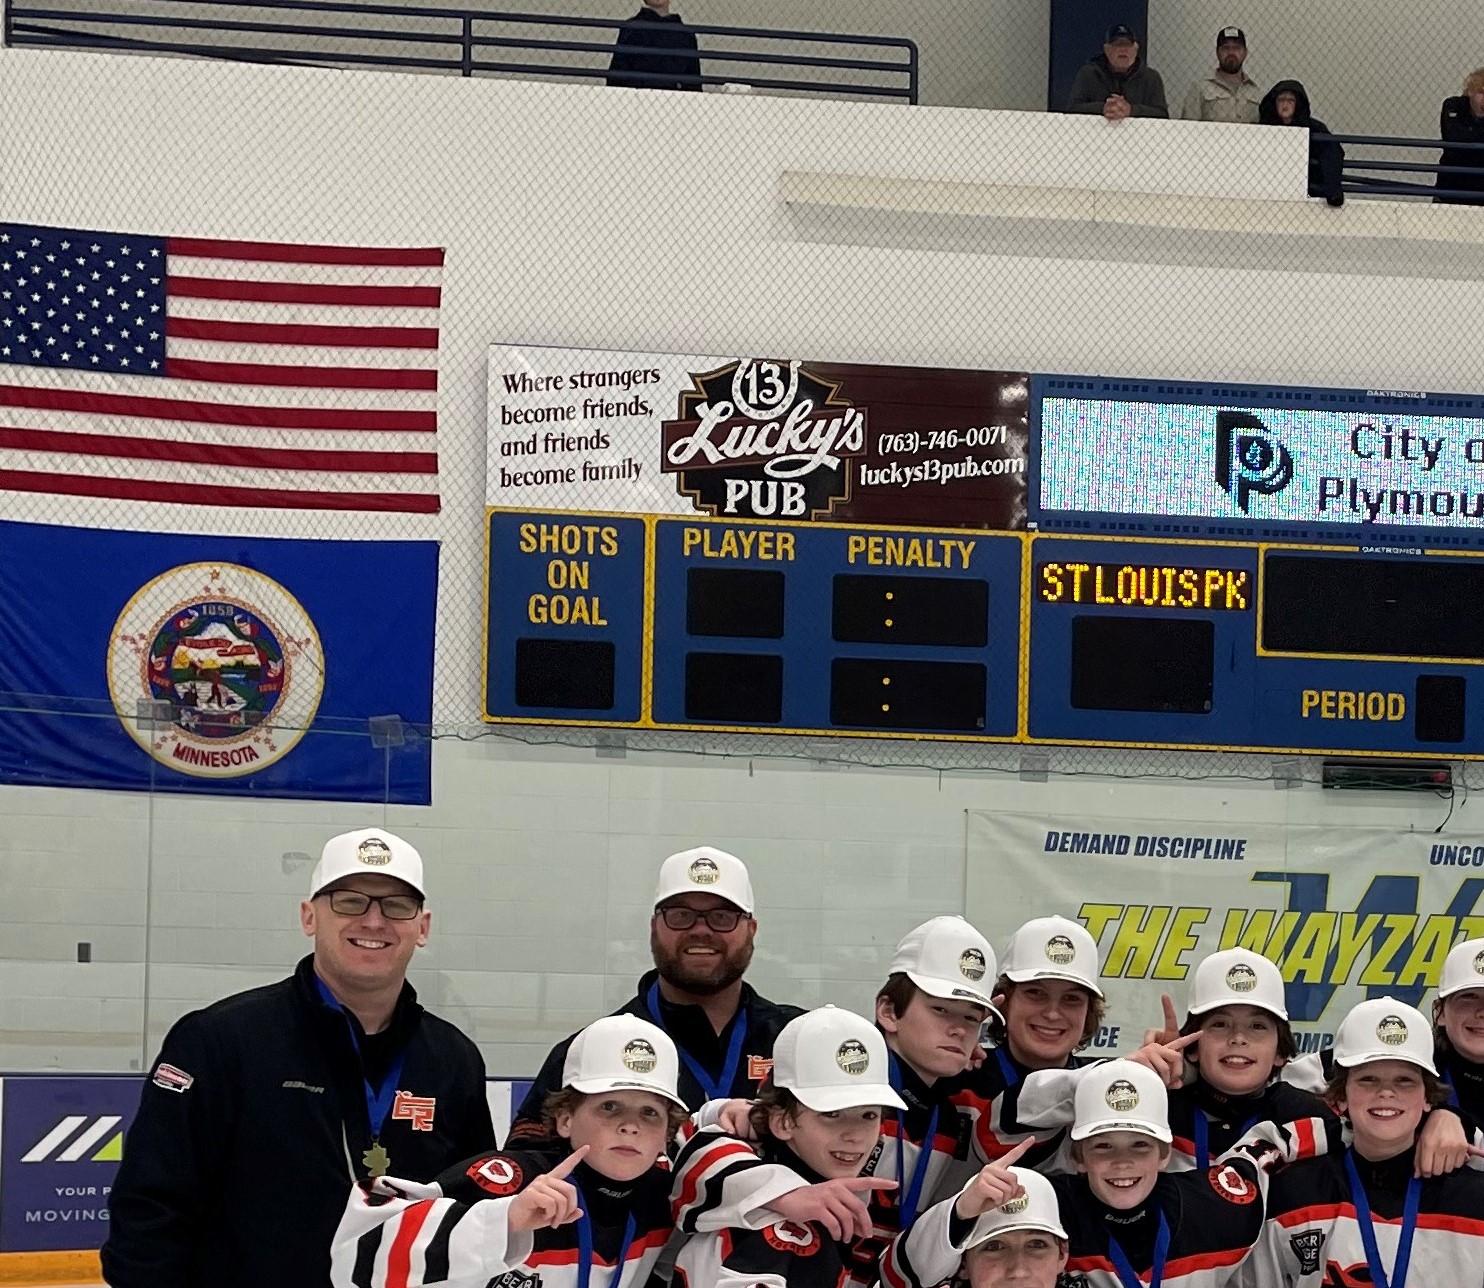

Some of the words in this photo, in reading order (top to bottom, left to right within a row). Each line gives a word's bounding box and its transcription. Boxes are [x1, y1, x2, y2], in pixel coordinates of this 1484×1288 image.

[503, 372, 563, 394] Where
[569, 365, 660, 391] strangers
[745, 366, 786, 404] 13
[501, 402, 579, 426] become
[581, 396, 654, 419] friends,
[501, 435, 538, 457] and
[543, 431, 610, 452] friends
[668, 399, 864, 479] Lucky's
[878, 425, 1006, 456] (763)-746-0071
[1351, 423, 1442, 470] City
[500, 466, 577, 489] become
[581, 459, 643, 485] family
[861, 456, 1025, 487] luckys13pub.com
[724, 480, 806, 515] PUB
[520, 523, 618, 556] SHOTS
[683, 528, 795, 560] PLAYER
[848, 536, 976, 569] PENALTY
[547, 561, 589, 589] ON
[528, 594, 608, 626] GOAL
[1301, 691, 1405, 722] PERIOD
[172, 743, 259, 767] MINNESOTA
[1044, 831, 1130, 855] DEMAND
[1134, 836, 1247, 860] DISCIPLINE
[1077, 903, 1212, 980] THE
[55, 1187, 96, 1197] YOUR
[103, 1187, 112, 1195] P
[25, 1209, 110, 1223] MOVING
